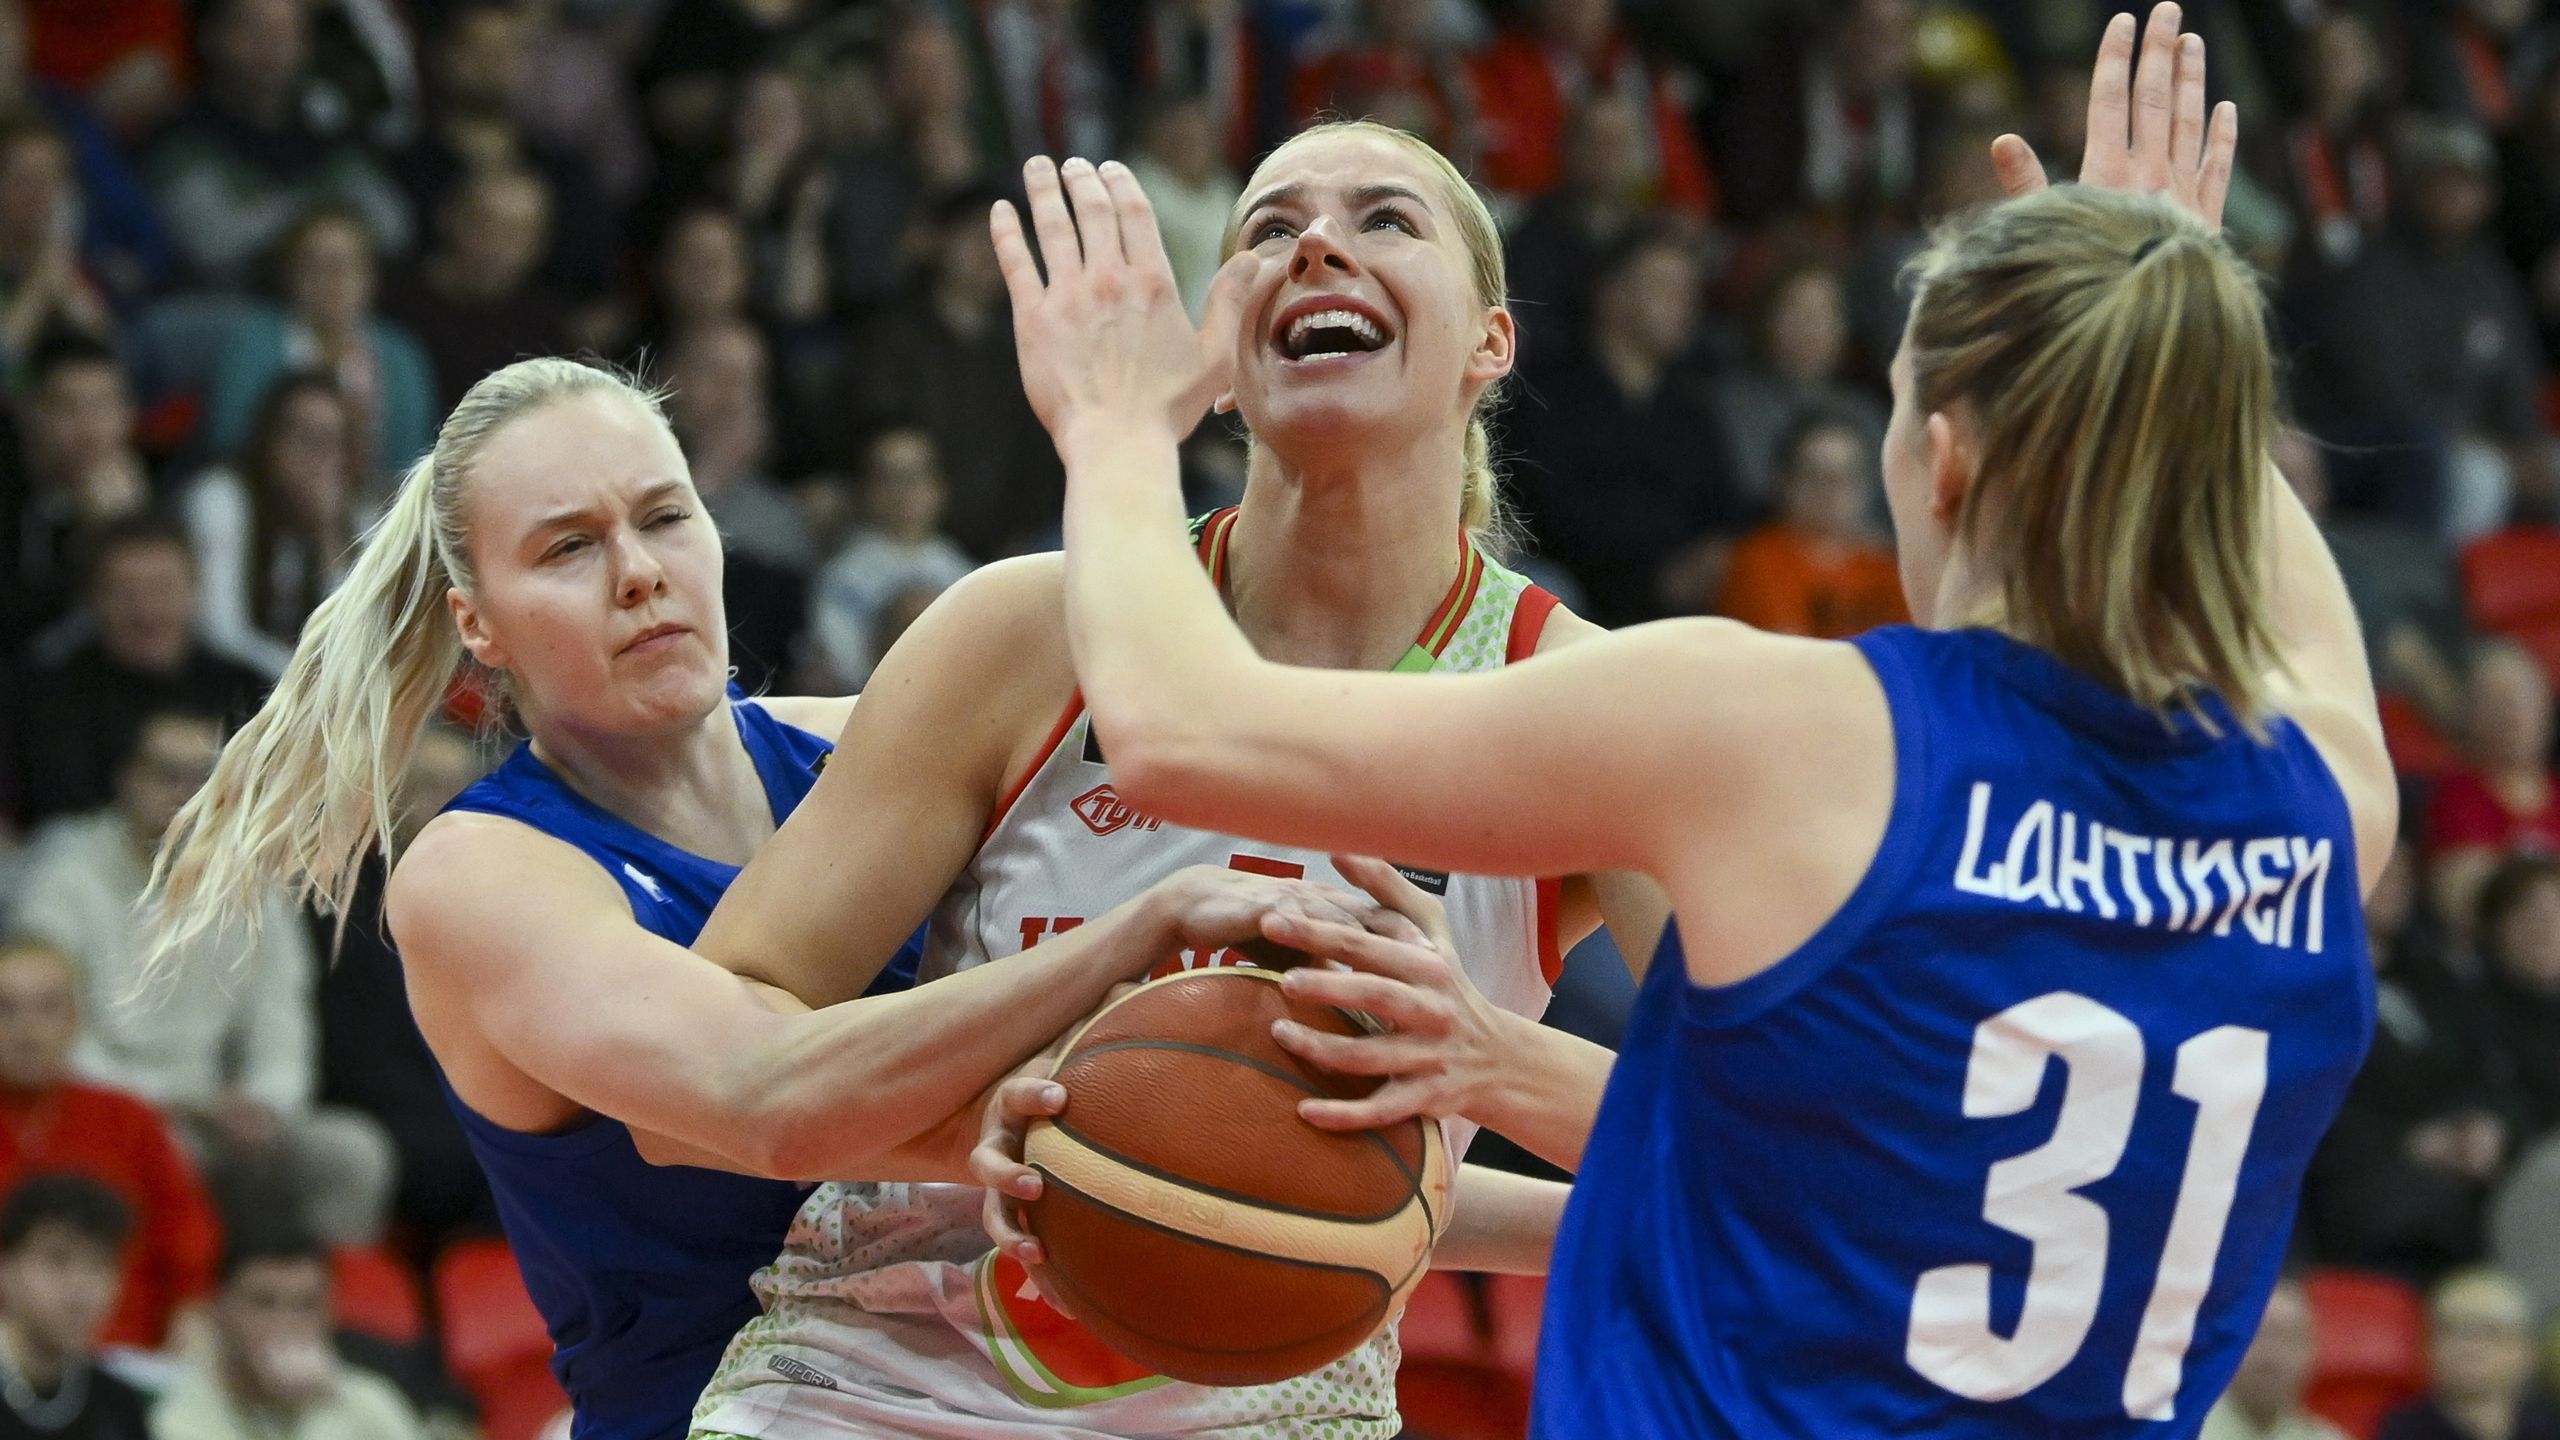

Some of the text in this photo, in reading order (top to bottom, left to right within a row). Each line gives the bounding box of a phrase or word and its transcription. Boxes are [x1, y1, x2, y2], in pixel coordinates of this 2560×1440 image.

[1410, 871, 1442, 886] Basketball
[1954, 781, 2331, 954] LAHTINEN
[1905, 990, 2270, 1422] 31
